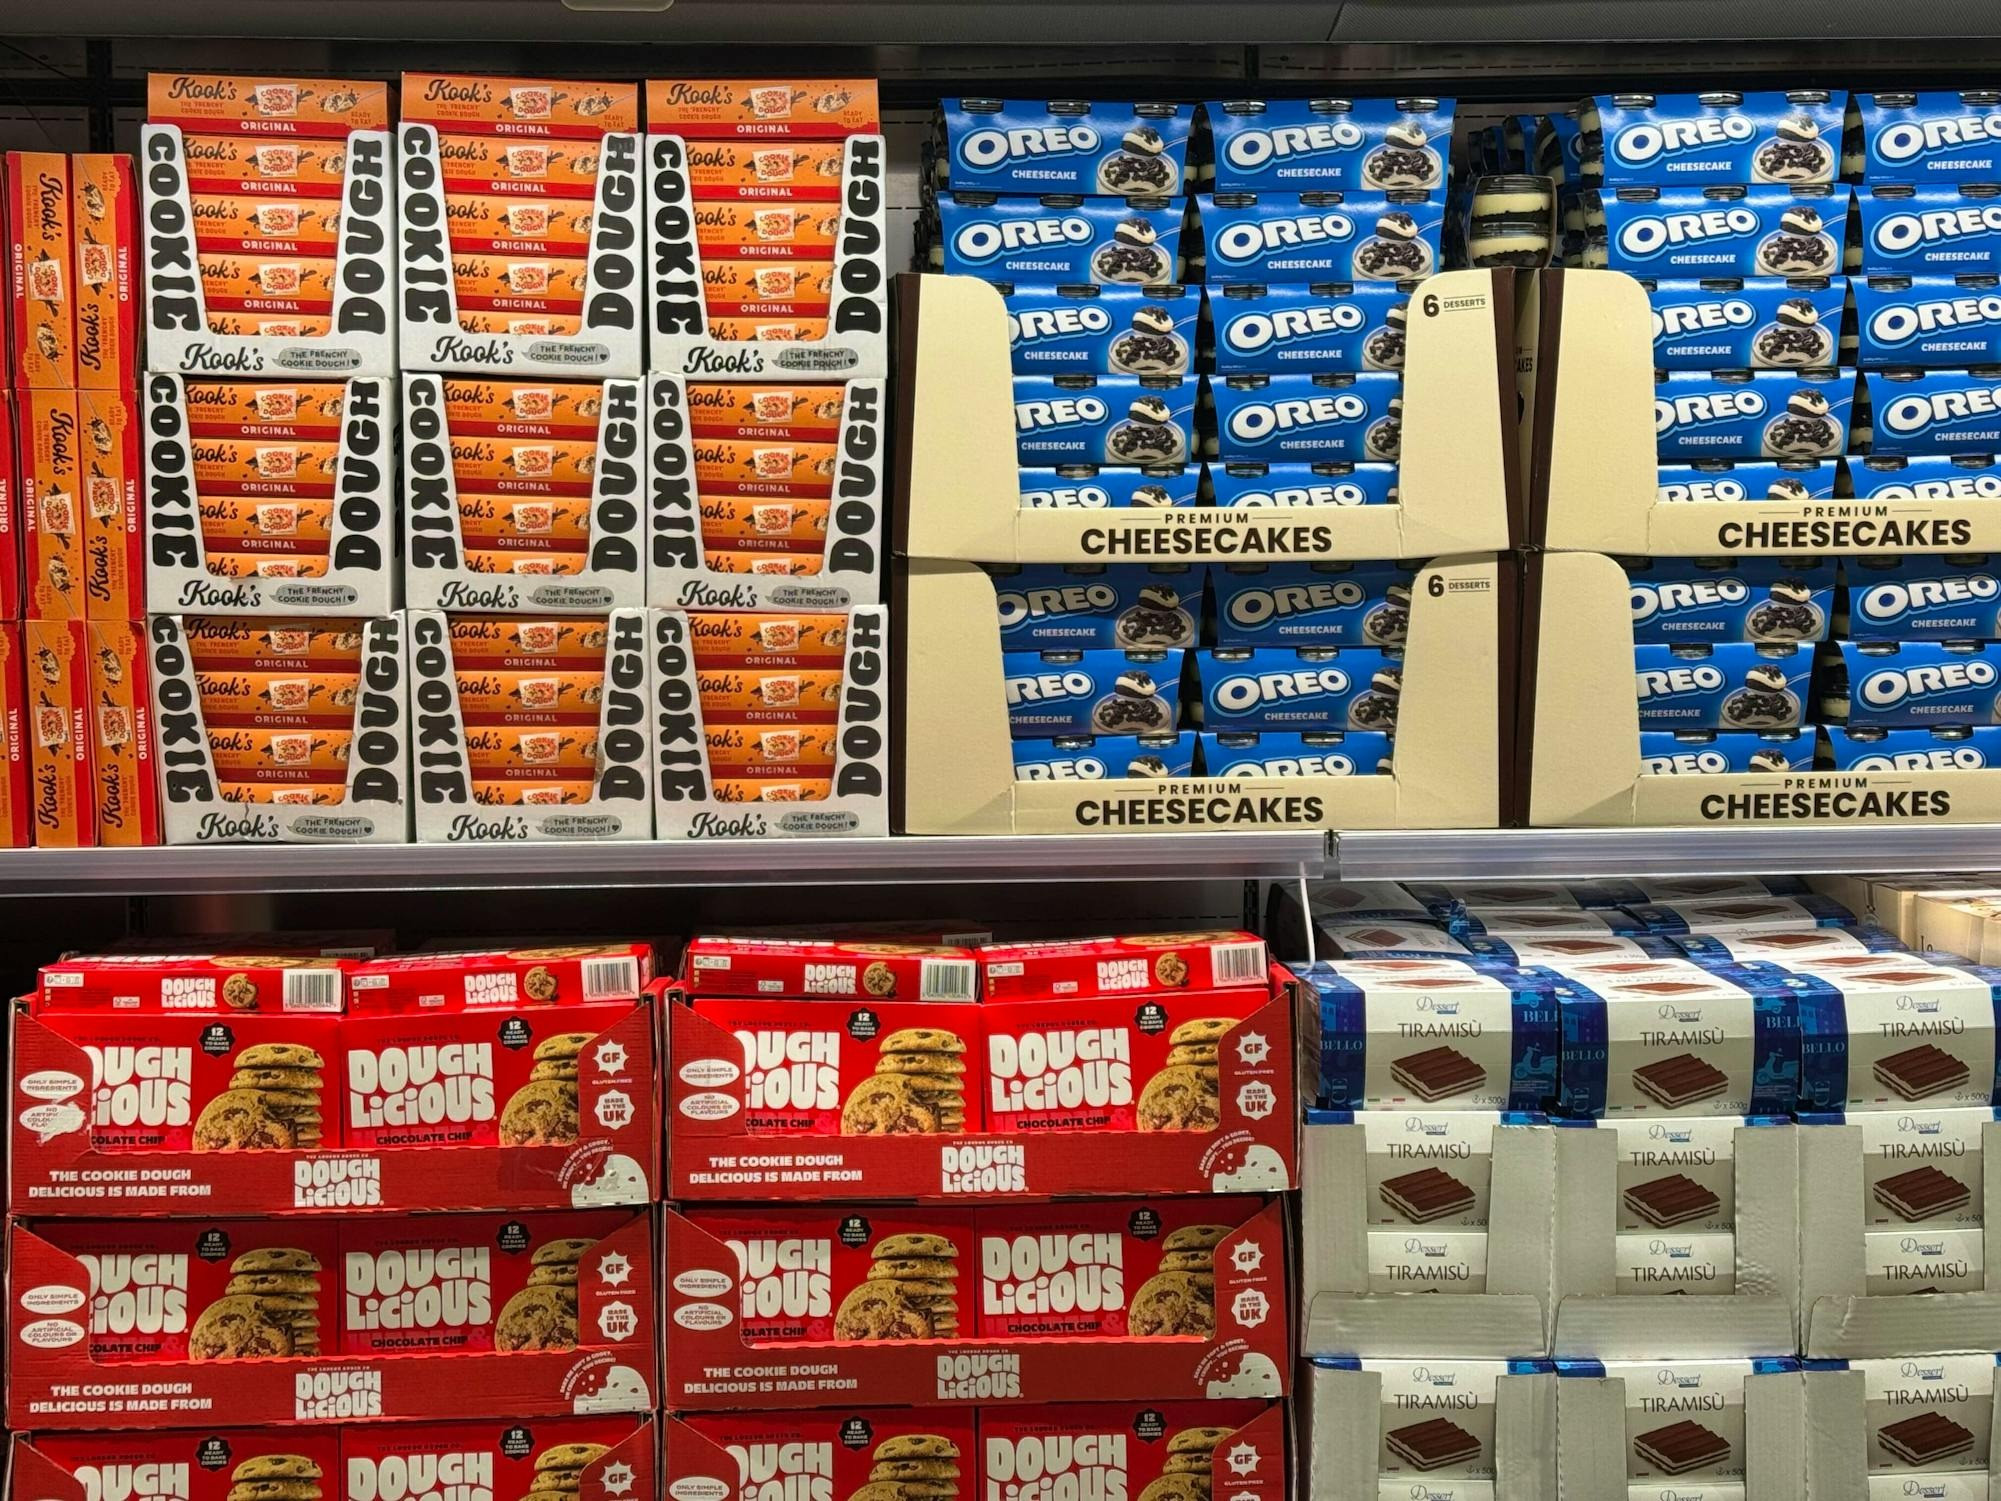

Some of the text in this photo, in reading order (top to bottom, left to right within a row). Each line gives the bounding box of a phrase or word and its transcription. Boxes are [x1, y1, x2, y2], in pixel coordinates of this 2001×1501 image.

[168, 77, 237, 100] Kook's
[424, 79, 492, 103] Kook's
[666, 83, 733, 105] Kook's
[241, 122, 297, 132] ORIGINAL
[495, 123, 551, 135] ORIGINAL
[736, 123, 791, 134] ORIGINAL
[964, 125, 1098, 166] OREO
[1228, 122, 1362, 165] OREO
[1618, 117, 1752, 161] OREO
[1012, 169, 1077, 180] CHEESECAKE
[1277, 167, 1341, 178] CHEESECAKE
[1666, 162, 1732, 172] CHEESECAKE
[1927, 160, 1992, 170] CHEESECAKE
[241, 182, 297, 192] ORIGINAL
[39, 173, 63, 241] Kook's
[148, 133, 200, 331] COOKIE
[338, 139, 386, 334] DOUGH
[404, 127, 451, 324] COOKIE
[587, 136, 635, 331] DOUGH
[835, 140, 881, 333] DOUGH
[1218, 215, 1353, 257] OREO
[1622, 209, 1757, 253] OREO
[653, 140, 704, 335] COOKIE
[958, 218, 1092, 258] OREO
[14, 243, 23, 298] ORIGINAL
[1006, 261, 1070, 271] CHEESECAKE
[1267, 259, 1332, 270] CHEESECAKE
[1670, 255, 1736, 265] CHEESECAKE
[1422, 295, 1486, 317] 6 DESSERTS
[81, 303, 101, 371] Kook's
[1228, 305, 1363, 348] OREO
[180, 343, 264, 372] Kook's
[290, 350, 347, 359] THE FRENCHY
[430, 336, 514, 365] Kook's
[530, 353, 562, 362] COOKIE
[558, 345, 596, 353] FRENCHY
[683, 346, 765, 374] Kook's
[1024, 351, 1089, 361] CHEESECAKE
[1278, 349, 1343, 360] CHEESECAKE
[281, 360, 313, 368] COOKIE
[1231, 395, 1365, 439] OREO
[241, 425, 296, 436] ORIGINAL
[497, 424, 551, 435] ORIGINAL
[737, 427, 791, 437] ORIGINAL
[1280, 439, 1345, 450] CHEESECAKE
[150, 375, 199, 568] COOKIE
[334, 380, 382, 570] DOUGH
[409, 379, 458, 570] COOKIE
[592, 384, 638, 572] DOUGH
[653, 379, 698, 568] COOKIE
[829, 387, 878, 574] DOUGH
[1165, 513, 1249, 524] PREMIUM
[1804, 507, 1888, 517] PREMIUM
[1080, 528, 1332, 554] CHEESECAKES
[1718, 520, 1971, 548] CHEESECAKES
[178, 581, 261, 607] Kook's
[437, 581, 519, 609] Kook's
[677, 580, 758, 609] Kook's
[1429, 575, 1490, 597] 6 DESSERTS
[1864, 576, 1999, 618] OREO
[1231, 583, 1363, 623] OREO
[1278, 625, 1343, 635] CHEESECAKE
[1912, 619, 1976, 628] CHEESECAKE
[255, 659, 309, 668] ORIGINAL
[504, 657, 557, 668] ORIGINAL
[745, 656, 798, 666] ORIGINAL
[1217, 670, 1348, 711] OREO
[1863, 662, 1996, 704] OREO
[152, 618, 214, 803] COOKIE
[352, 619, 399, 803] DOUGH
[414, 618, 468, 804] COOKIE
[599, 616, 645, 801] DOUGH
[656, 617, 707, 802] COOKIE
[837, 614, 881, 797] DOUGH
[1158, 784, 1241, 795] PREMIUM
[1784, 779, 1867, 788] PREMIUM
[37, 763, 57, 829] Kook's
[1700, 791, 1951, 820] CHEESECAKES
[1075, 797, 1324, 826] CHEESECAKES
[196, 812, 279, 839] Kook's
[447, 815, 528, 841] Kook's
[687, 812, 767, 839] Kook's
[1416, 996, 1460, 1014] Dessert
[1658, 1005, 1702, 1022] Dessert
[1896, 996, 1940, 1012] Dessert
[1398, 1020, 1482, 1038] TIRAMISÙ
[1640, 1026, 1725, 1046] TIRAMISÙ
[1879, 1017, 1964, 1038] TIRAMISÙ
[989, 1028, 1129, 1078] DOUGH
[1320, 1040, 1363, 1050] BELLO
[1802, 1043, 1845, 1053] BELLO
[348, 1043, 492, 1094] DOUGH
[602, 1052, 620, 1063] GF
[603, 1110, 625, 1122] UK
[377, 1132, 472, 1144] CHOCOLATE CHIP
[1879, 1139, 1965, 1159] TIRAMISÙ
[942, 1145, 1024, 1173] DOUGH
[1387, 1141, 1471, 1159] TIRAMISÙ
[1630, 1146, 1716, 1166] TIRAMISÙ
[50, 1169, 191, 1181] THE COOKIE DOUGH
[294, 1159, 380, 1188] DOUGH
[29, 1185, 211, 1197] DELICIOUS IS MADE FROM
[982, 1233, 1123, 1282] DOUGH
[346, 1247, 490, 1296] DOUGH
[605, 1264, 624, 1274] GF
[1386, 1262, 1470, 1281] TIRAMISÙ
[1631, 1261, 1716, 1281] TIRAMISÙ
[1883, 1260, 1968, 1281] TIRAMISÙ
[1241, 1309, 1261, 1320] UK
[1008, 1321, 1102, 1333] CHOCOLATE CHIP
[937, 1354, 1020, 1381] DOUGH
[1393, 1391, 1478, 1410] TIRAMISÙ
[1639, 1392, 1725, 1412] TIRAMISÙ
[1883, 1386, 1969, 1406] TIRAMISÙ
